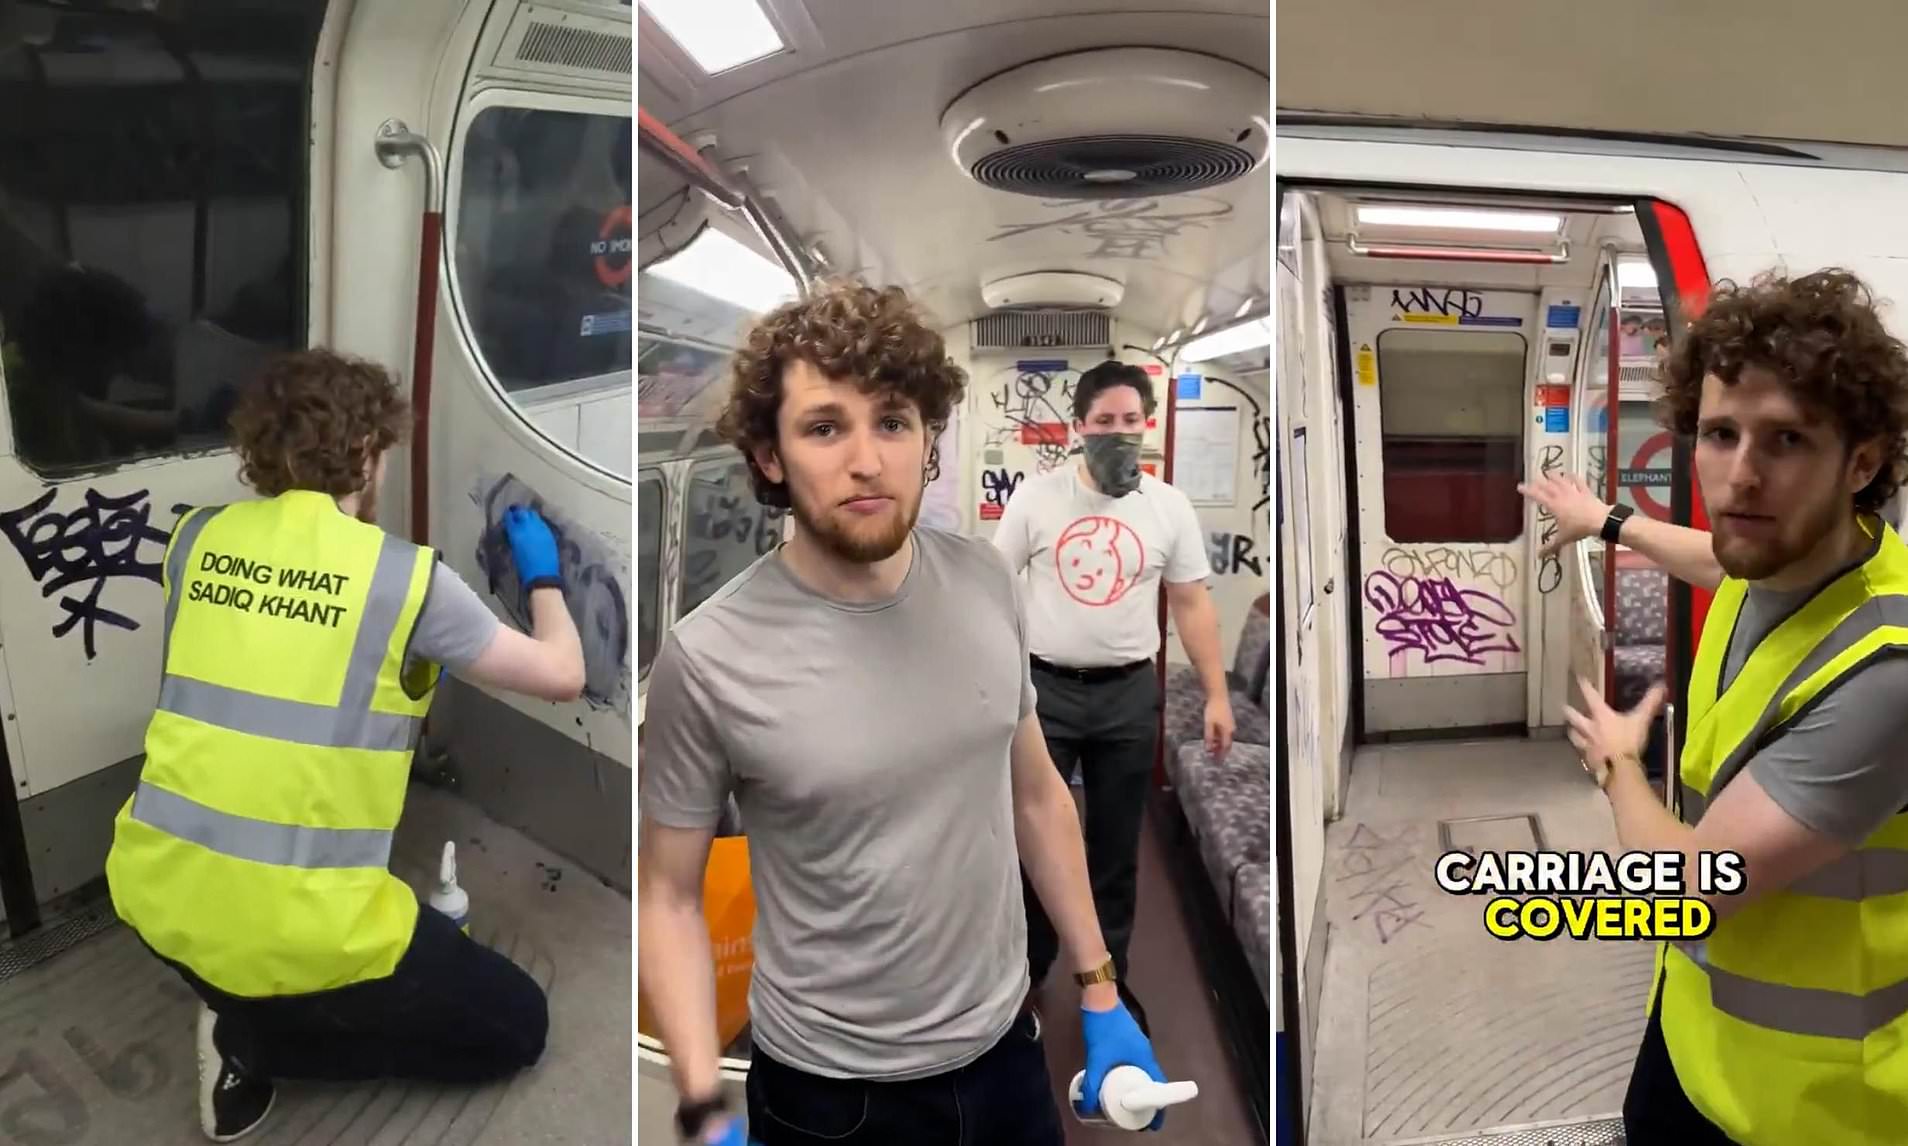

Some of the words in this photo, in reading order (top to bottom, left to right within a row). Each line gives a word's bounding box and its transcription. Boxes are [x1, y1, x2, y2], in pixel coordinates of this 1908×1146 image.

[200, 551, 272, 585] DOING
[278, 568, 350, 596] WHAT
[188, 580, 254, 613] SADIQ
[258, 594, 348, 628] KHANT
